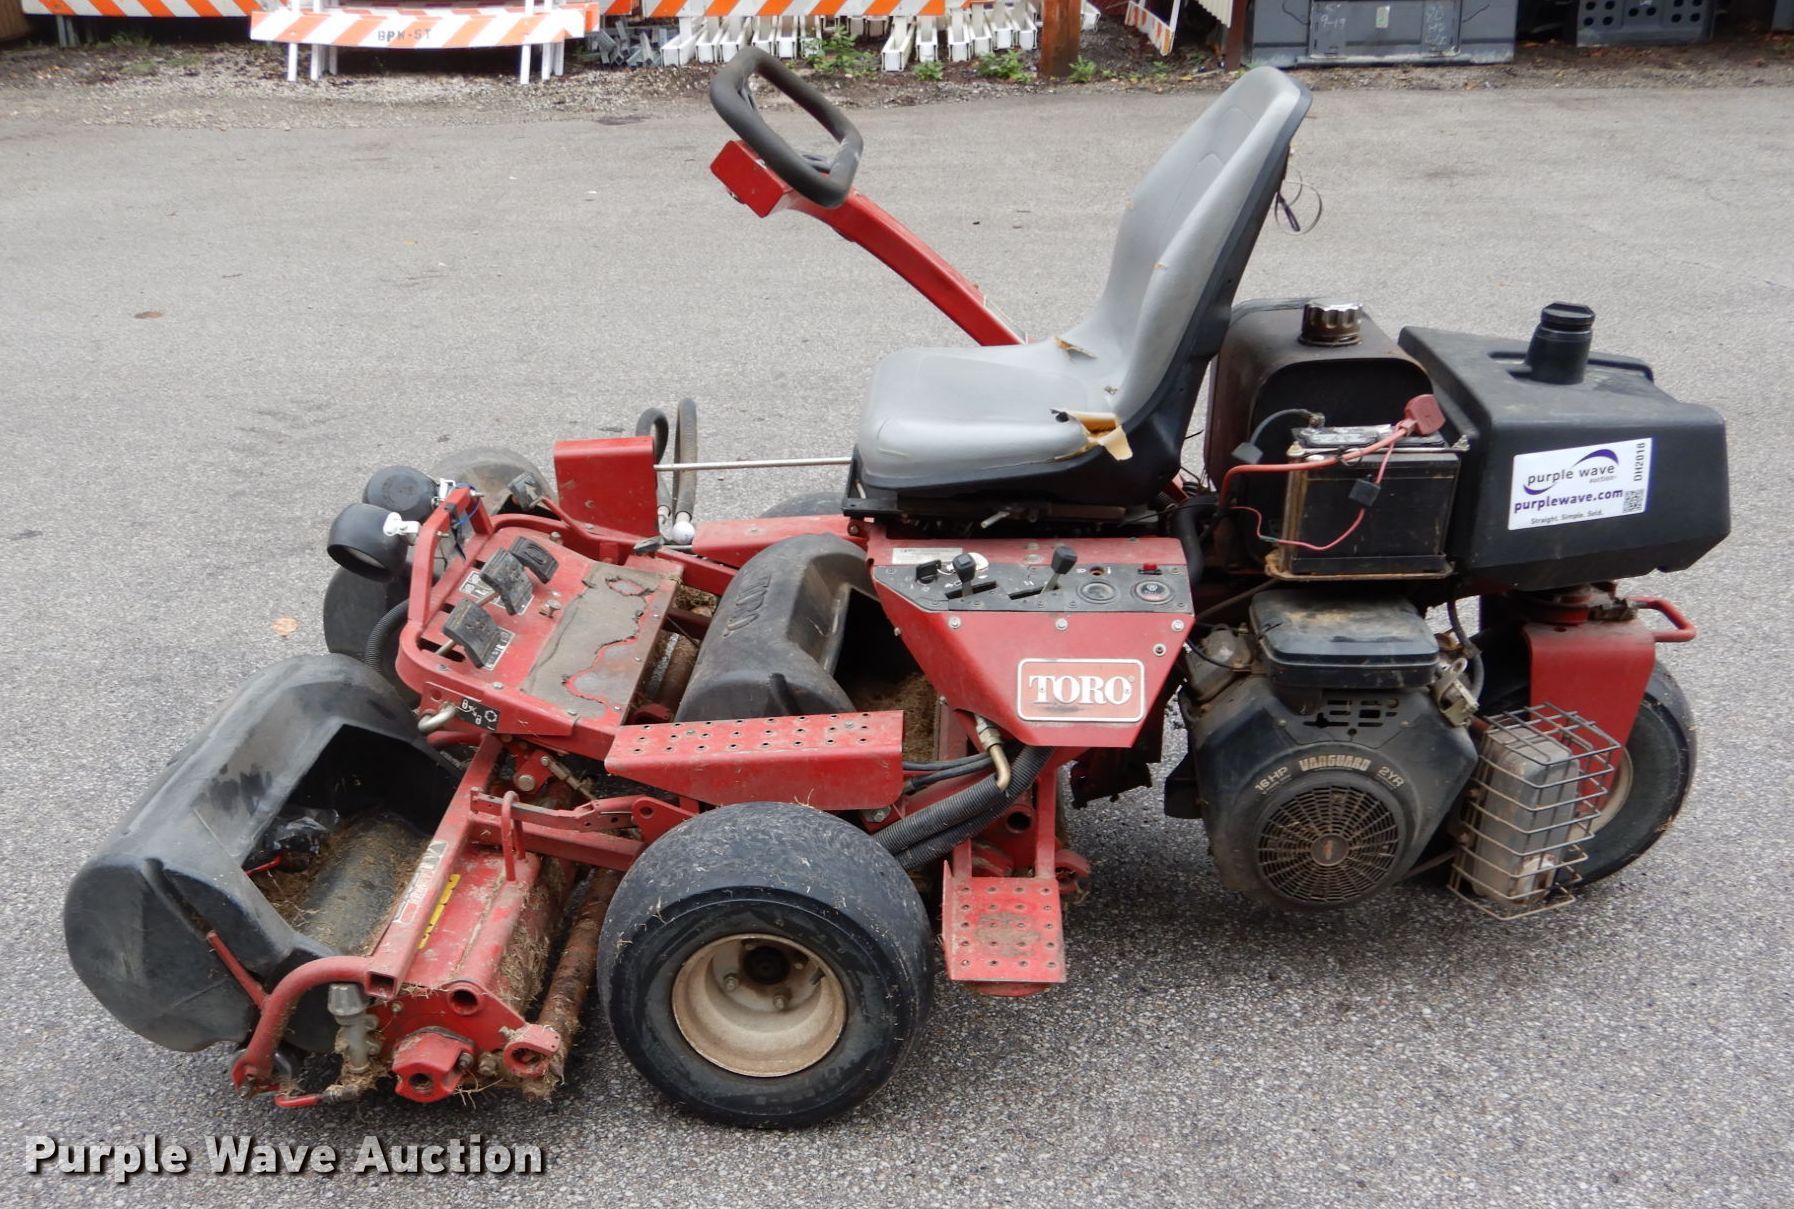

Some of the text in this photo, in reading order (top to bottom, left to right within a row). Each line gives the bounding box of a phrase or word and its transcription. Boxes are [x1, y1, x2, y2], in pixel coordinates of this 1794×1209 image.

[1527, 464, 1615, 486] purple wave
[1513, 489, 1624, 514] purplewave.com
[1028, 675, 1132, 705] TORO
[1299, 754, 1372, 772] VANGUARD
